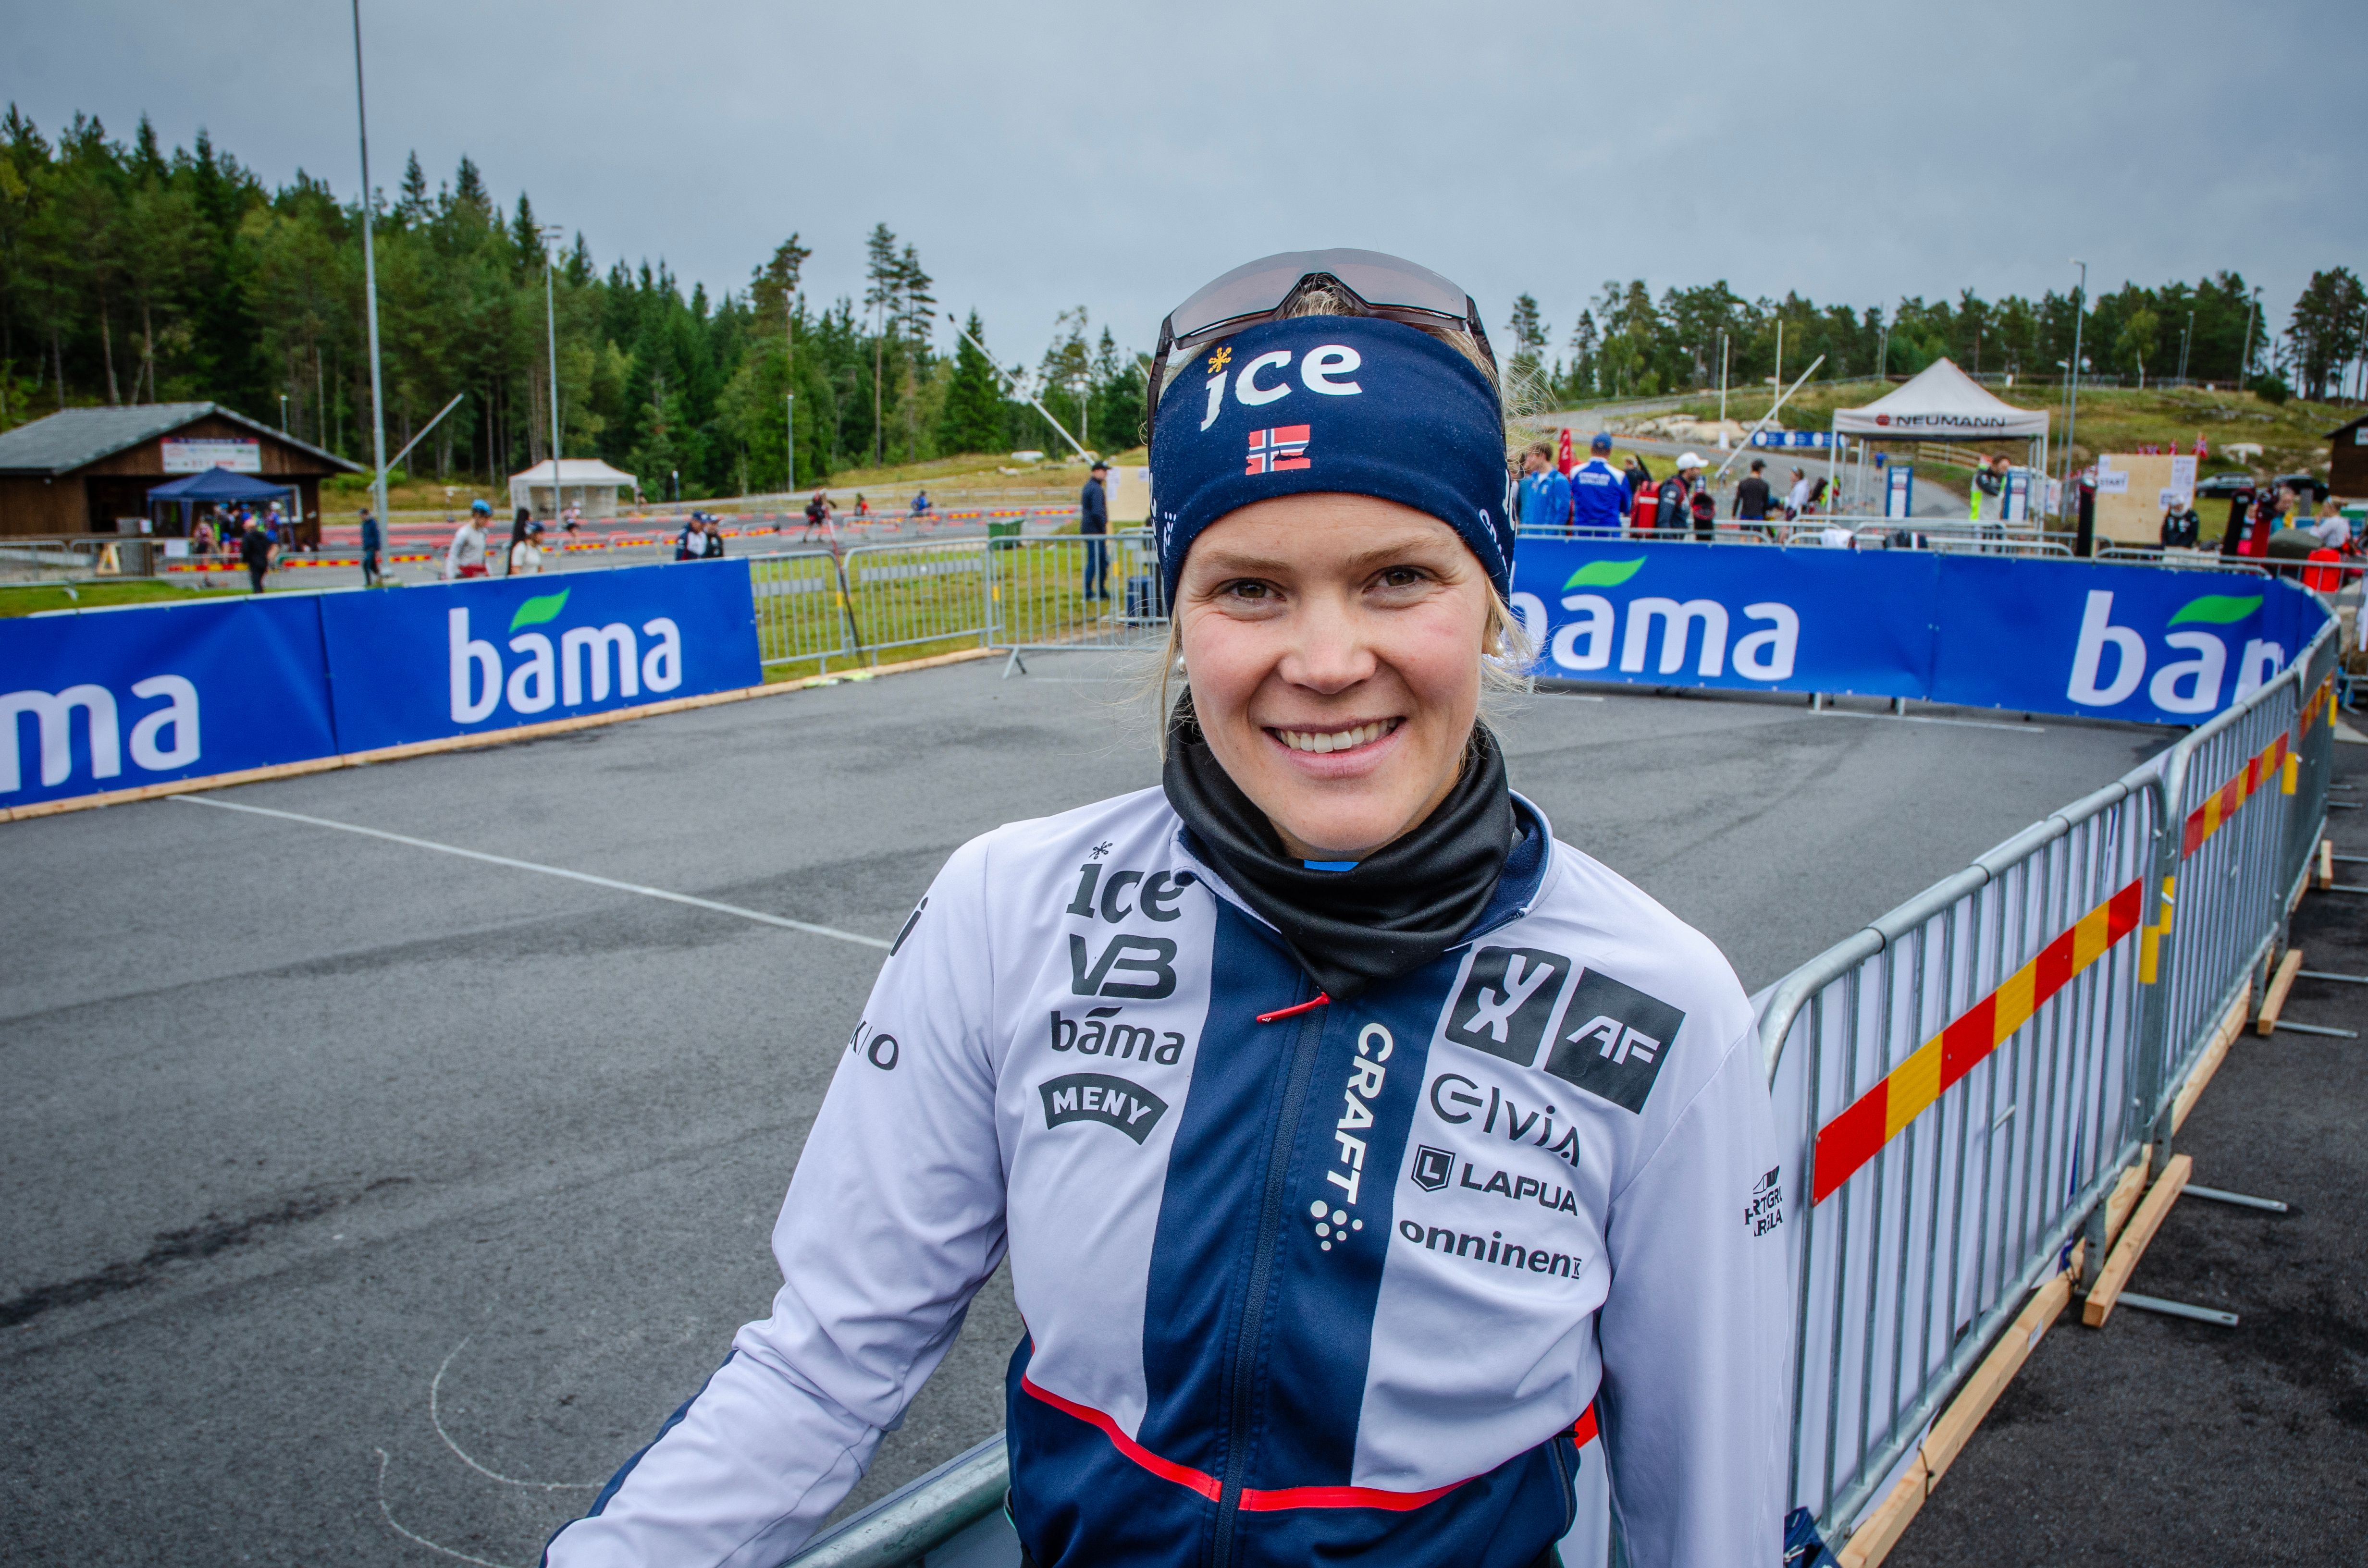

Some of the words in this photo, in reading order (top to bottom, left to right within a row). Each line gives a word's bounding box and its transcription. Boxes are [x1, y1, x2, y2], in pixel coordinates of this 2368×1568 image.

[1896, 415, 2005, 427] NEUMANN
[449, 607, 682, 721] bama
[1066, 841, 1187, 924] ice
[1070, 933, 1178, 1000] VB
[1566, 1015, 1661, 1065] AF
[1052, 1086, 1152, 1125] MENY
[1326, 1022, 1394, 1205] CRAFT
[1459, 1163, 1579, 1217] LAPUA
[1399, 1219, 1571, 1278] onninen
